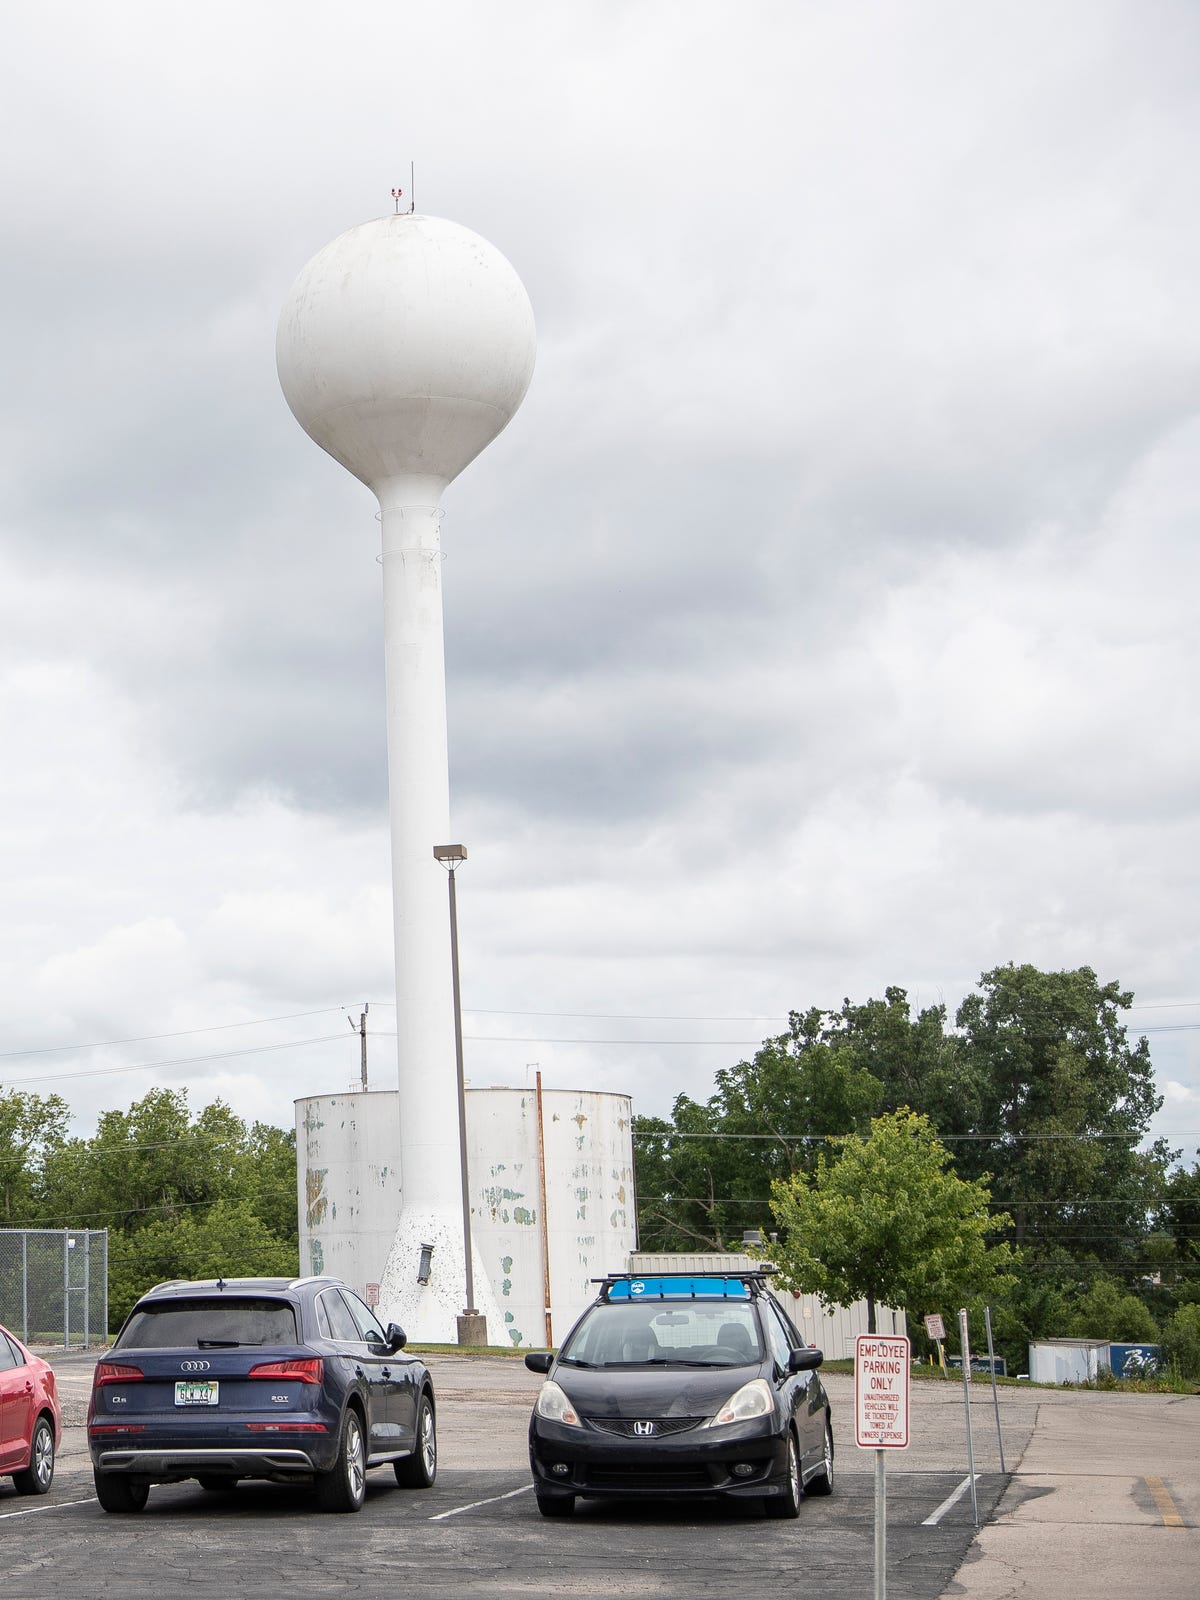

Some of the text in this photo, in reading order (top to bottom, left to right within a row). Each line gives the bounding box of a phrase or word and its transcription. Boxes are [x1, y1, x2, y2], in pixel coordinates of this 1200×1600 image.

[859, 1344, 905, 1358] EMPLOYEE
[863, 1361, 901, 1374] PARKING
[870, 1377, 894, 1390] ONLY
[863, 1393, 900, 1402] UNAUTHORIZED
[863, 1402, 899, 1411] VEHICLES WILL
[864, 1412, 871, 1420] BE
[869, 1421, 894, 1430] TOWED AT
[861, 1431, 903, 1440] OWNERS EXPENSE
